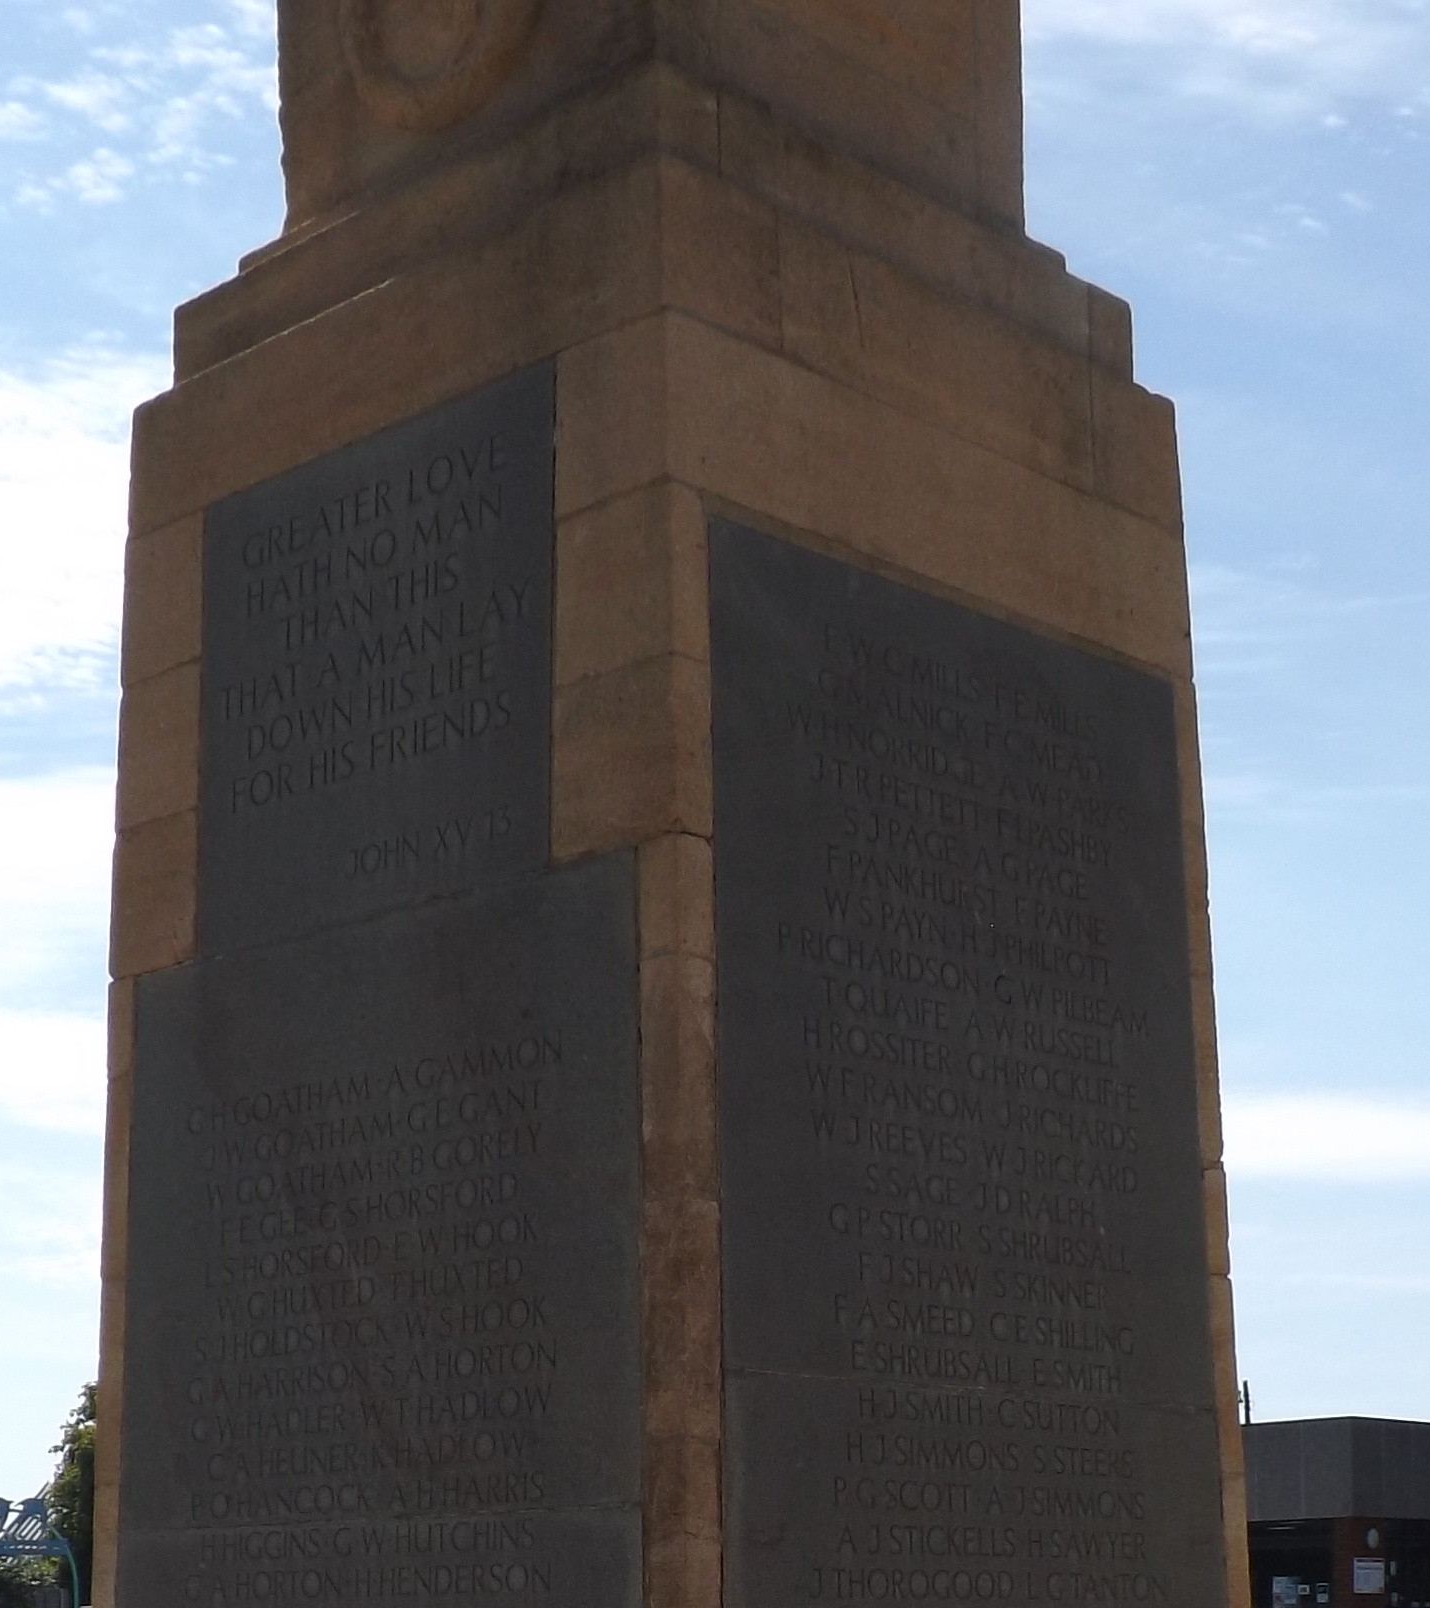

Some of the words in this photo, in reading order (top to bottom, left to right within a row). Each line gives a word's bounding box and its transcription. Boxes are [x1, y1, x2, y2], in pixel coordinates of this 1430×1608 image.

[242, 479, 391, 569] GREATER
[408, 430, 508, 507] LOVE
[247, 553, 331, 617] HATH
[346, 529, 397, 579] NO
[413, 483, 501, 553] MAN
[279, 584, 372, 650] THAN
[389, 552, 458, 611] THIS
[221, 661, 301, 721] THAT
[316, 652, 340, 688] A
[358, 609, 443, 676] MAN
[460, 573, 536, 637] LAY
[247, 691, 352, 761] DOWN
[368, 671, 415, 721] HIS
[431, 642, 495, 699] LIFE
[232, 763, 294, 815] FOR
[309, 740, 355, 790] HIS
[370, 689, 511, 770] FRIENDS
[345, 830, 419, 879] JOHN
[435, 817, 472, 855] XV
[484, 806, 511, 840] 13
[889, 819, 959, 866] PAGE
[1026, 859, 1089, 900] PAGE
[849, 850, 1000, 916] PANKHURST
[1034, 902, 1106, 946] PAYNE
[881, 902, 946, 947] PAYN
[1005, 933, 1111, 987] PHILPOTT
[801, 927, 980, 998] RICHARDSON
[1052, 987, 1149, 1037] PILBEAM
[845, 981, 949, 1031] QUAIFE
[1024, 1020, 1119, 1068] RUSSELL
[233, 1072, 370, 1126] GOATHAM
[415, 1029, 563, 1089] GAMMON
[830, 1020, 950, 1075] ROSSITER
[1016, 1062, 1140, 1112] ROCKLIFFE
[255, 1112, 393, 1161] GOATHAM
[459, 1079, 543, 1123] GANT
[864, 1071, 983, 1122] RANSOM
[1020, 1105, 1138, 1154] RICHARDS
[237, 1159, 373, 1204] GOATHAM
[433, 1122, 542, 1171] GORELY
[871, 1119, 967, 1164] REEVES
[1035, 1150, 1138, 1194] RICKARD
[366, 1172, 517, 1222] HORSFORD
[887, 1167, 960, 1206] SAGE
[1021, 1189, 1096, 1229] RALPH
[243, 1236, 380, 1282] HORSFORD
[453, 1211, 537, 1251] HOOK
[879, 1209, 962, 1250] STORR
[999, 1227, 1132, 1275] SHRUBSALL
[901, 1257, 979, 1293] SHAW
[1015, 1271, 1108, 1311] SKINNER
[235, 1317, 388, 1362] HOLDSTOCK
[462, 1296, 547, 1334] HOOK
[886, 1300, 974, 1337] SMEED
[1036, 1318, 1135, 1356] SHILLING
[239, 1360, 369, 1401] HARRISON
[436, 1338, 557, 1380] HORTON
[875, 1342, 1018, 1384] SHRUBSALL
[1053, 1360, 1121, 1393] SMITH
[248, 1403, 345, 1439] HADLER
[418, 1383, 552, 1425] HADLOW
[905, 1391, 983, 1425] SMITH
[1023, 1401, 1120, 1436] SUTTON
[394, 1431, 523, 1468] HADLOW
[894, 1434, 1019, 1472] SIMMONS
[237, 1484, 370, 1515] HANCOCK
[443, 1470, 545, 1502] HARRIS
[885, 1479, 972, 1512] SCOTT
[1033, 1486, 1146, 1520] SIMMONS
[223, 1528, 320, 1561] HIGGINS
[396, 1518, 535, 1553] HUTCHINS
[889, 1525, 1016, 1558] STICKELLS
[1050, 1529, 1147, 1561] SAWYER
[235, 1570, 341, 1599] HORTON
[380, 1561, 552, 1597] HENDERSON
[832, 1568, 1014, 1600] THOROGOOD
[1071, 1572, 1169, 1601] TANTON
